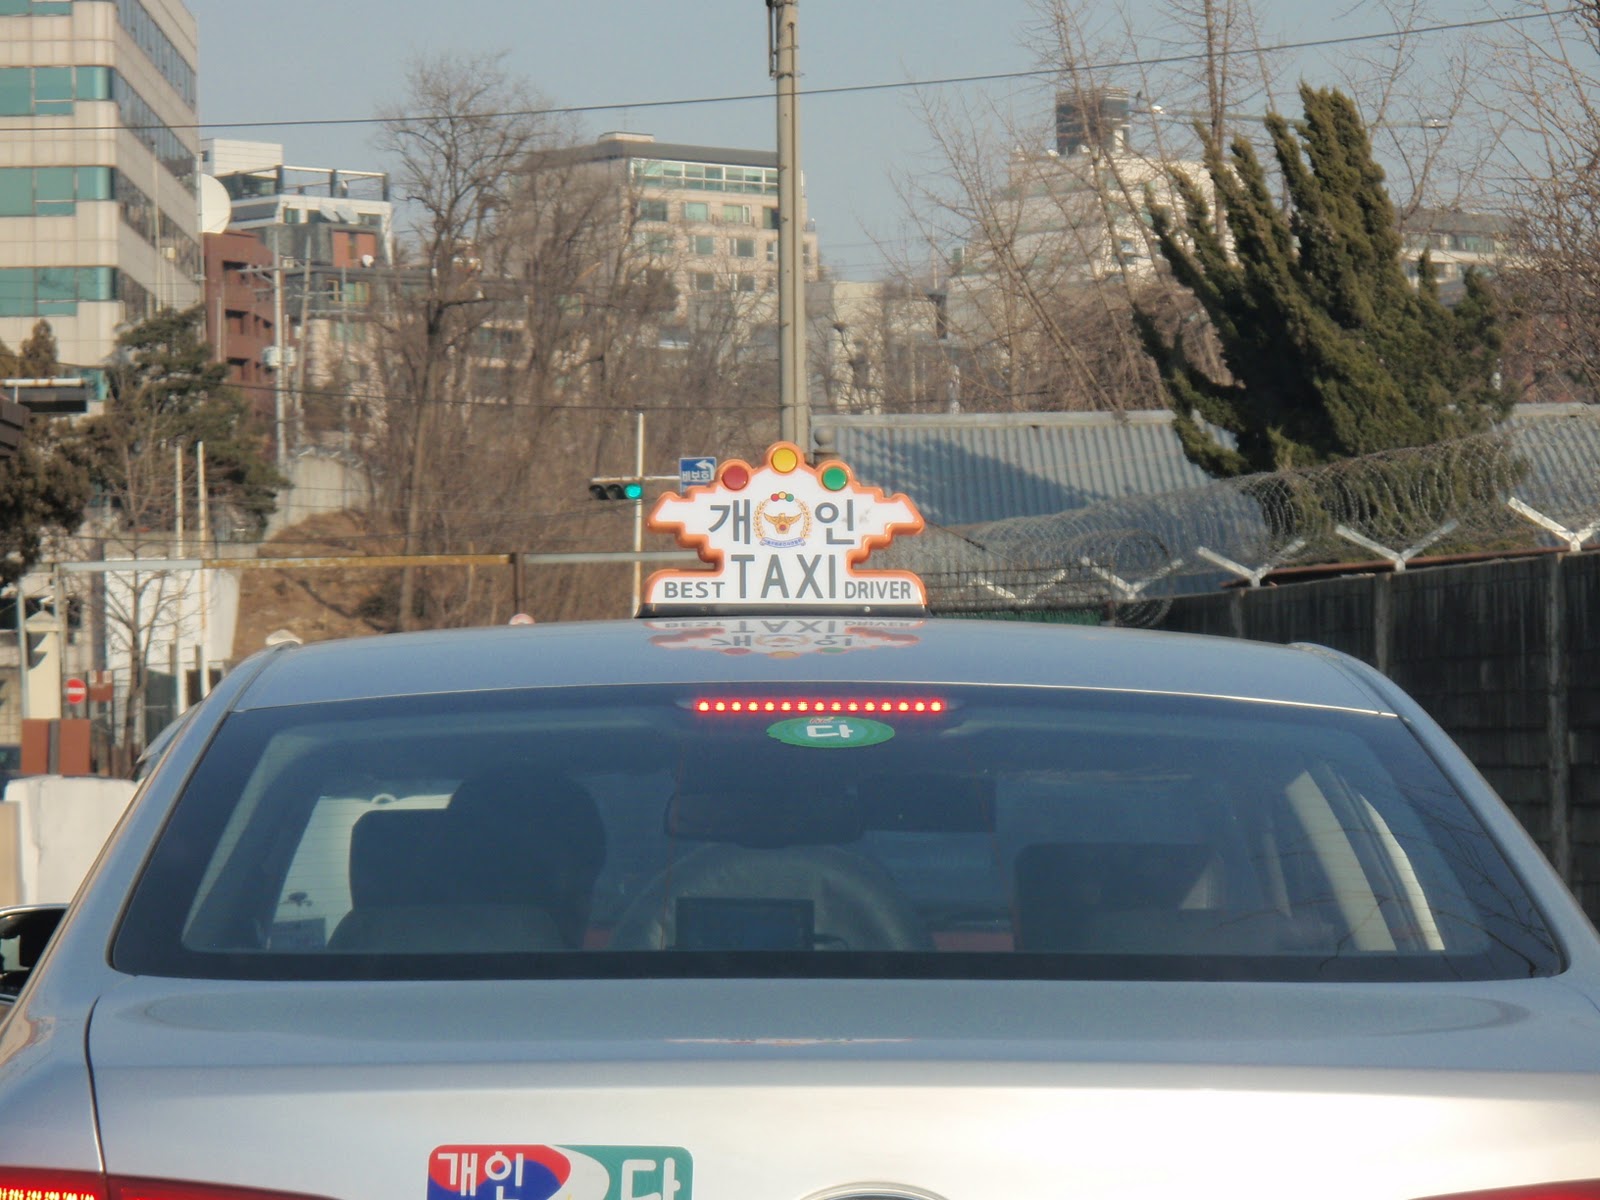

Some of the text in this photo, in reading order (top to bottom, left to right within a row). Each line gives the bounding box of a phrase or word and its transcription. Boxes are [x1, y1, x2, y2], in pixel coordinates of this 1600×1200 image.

[664, 554, 911, 599] BEST TAXI DRIVER
[806, 724, 853, 738] 다
[437, 1151, 524, 1200] 개인
